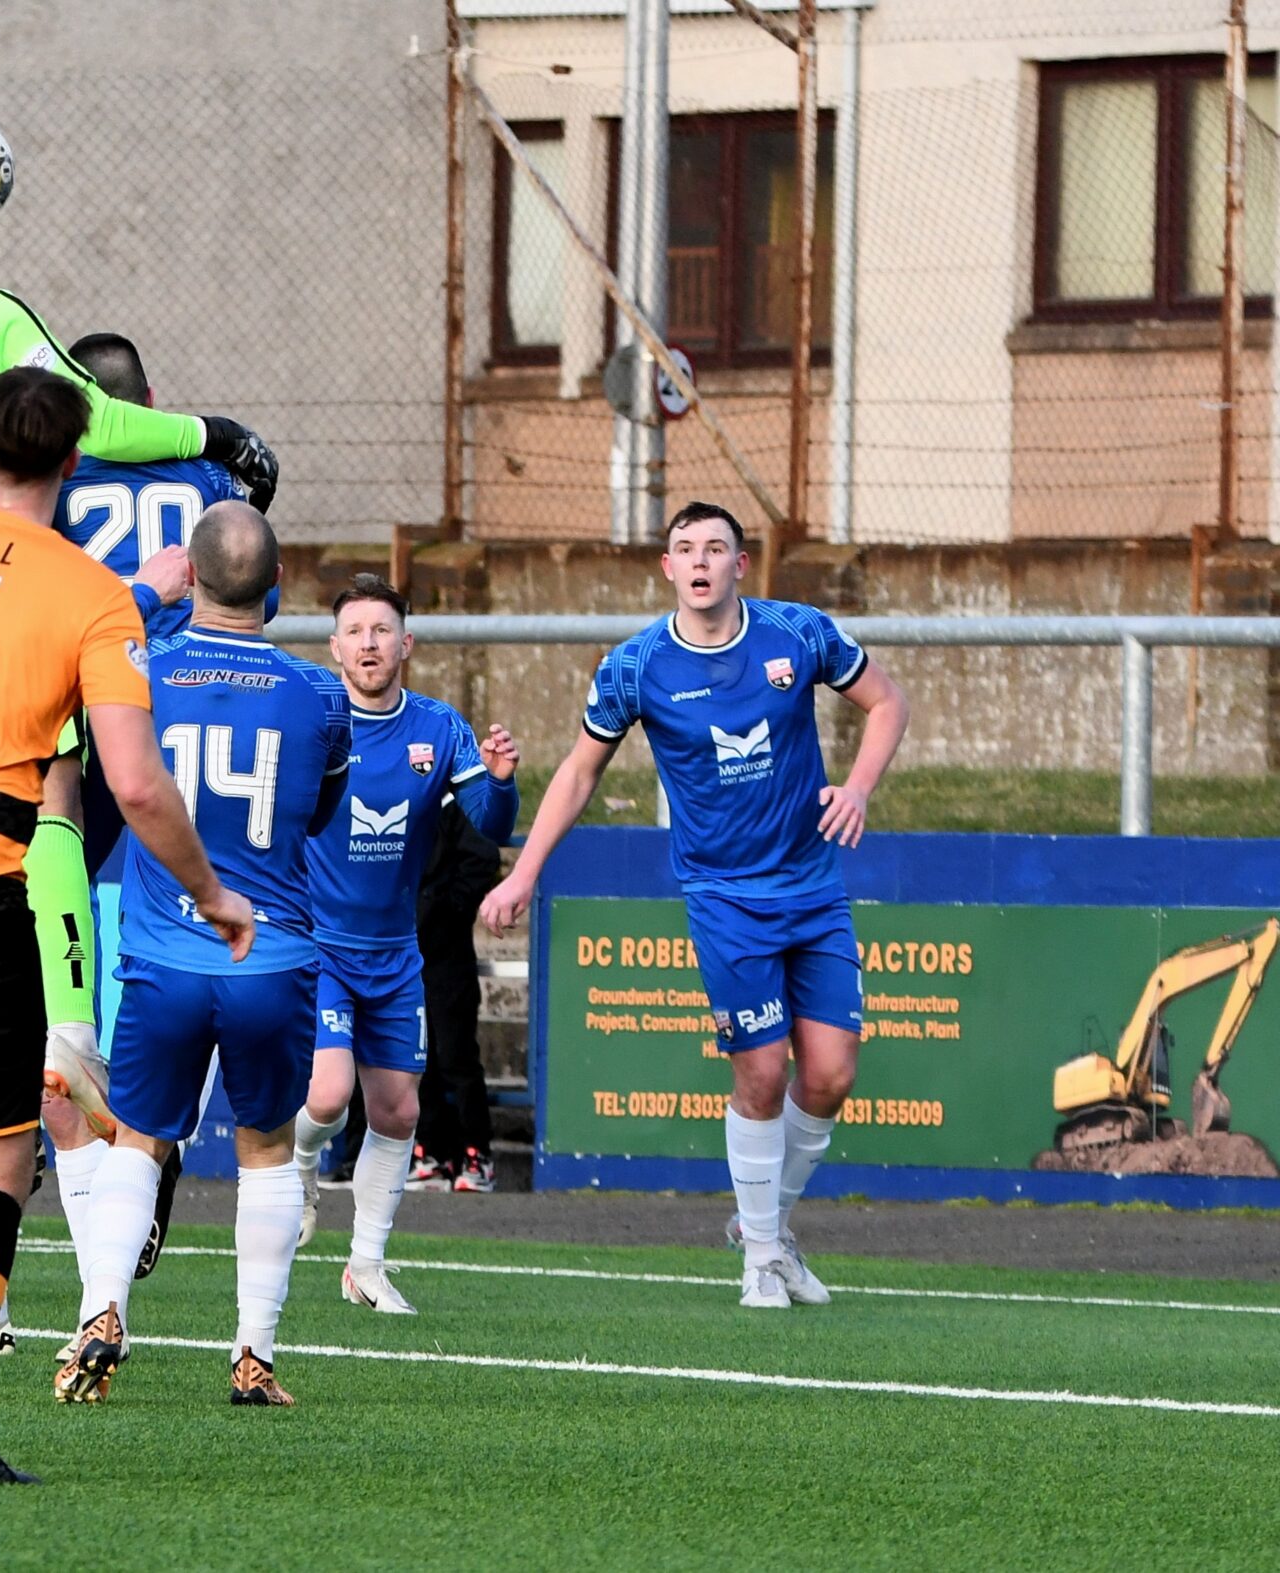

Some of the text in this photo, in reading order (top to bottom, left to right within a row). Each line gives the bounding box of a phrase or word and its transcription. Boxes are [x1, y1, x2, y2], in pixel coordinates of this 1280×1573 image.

[66, 482, 204, 589] 20
[171, 667, 278, 690] CARNEGIE
[670, 687, 712, 703] uhlsport
[718, 758, 774, 777] Montrose
[161, 723, 282, 850] 14
[349, 839, 405, 853] Montrose
[348, 853, 404, 863] PORT AUTHORITY
[577, 936, 613, 967] DC
[588, 987, 666, 1006] Groundwork
[867, 993, 960, 1014] Infrastructure
[585, 1011, 640, 1035] Projects,
[641, 1013, 700, 1033] Concrete
[736, 998, 784, 1028] RJM
[878, 1020, 923, 1041] Works,
[925, 1020, 961, 1040] Plant
[593, 1091, 626, 1116] TEL:
[628, 1092, 678, 1117] 01307
[875, 1099, 944, 1126] 355009
